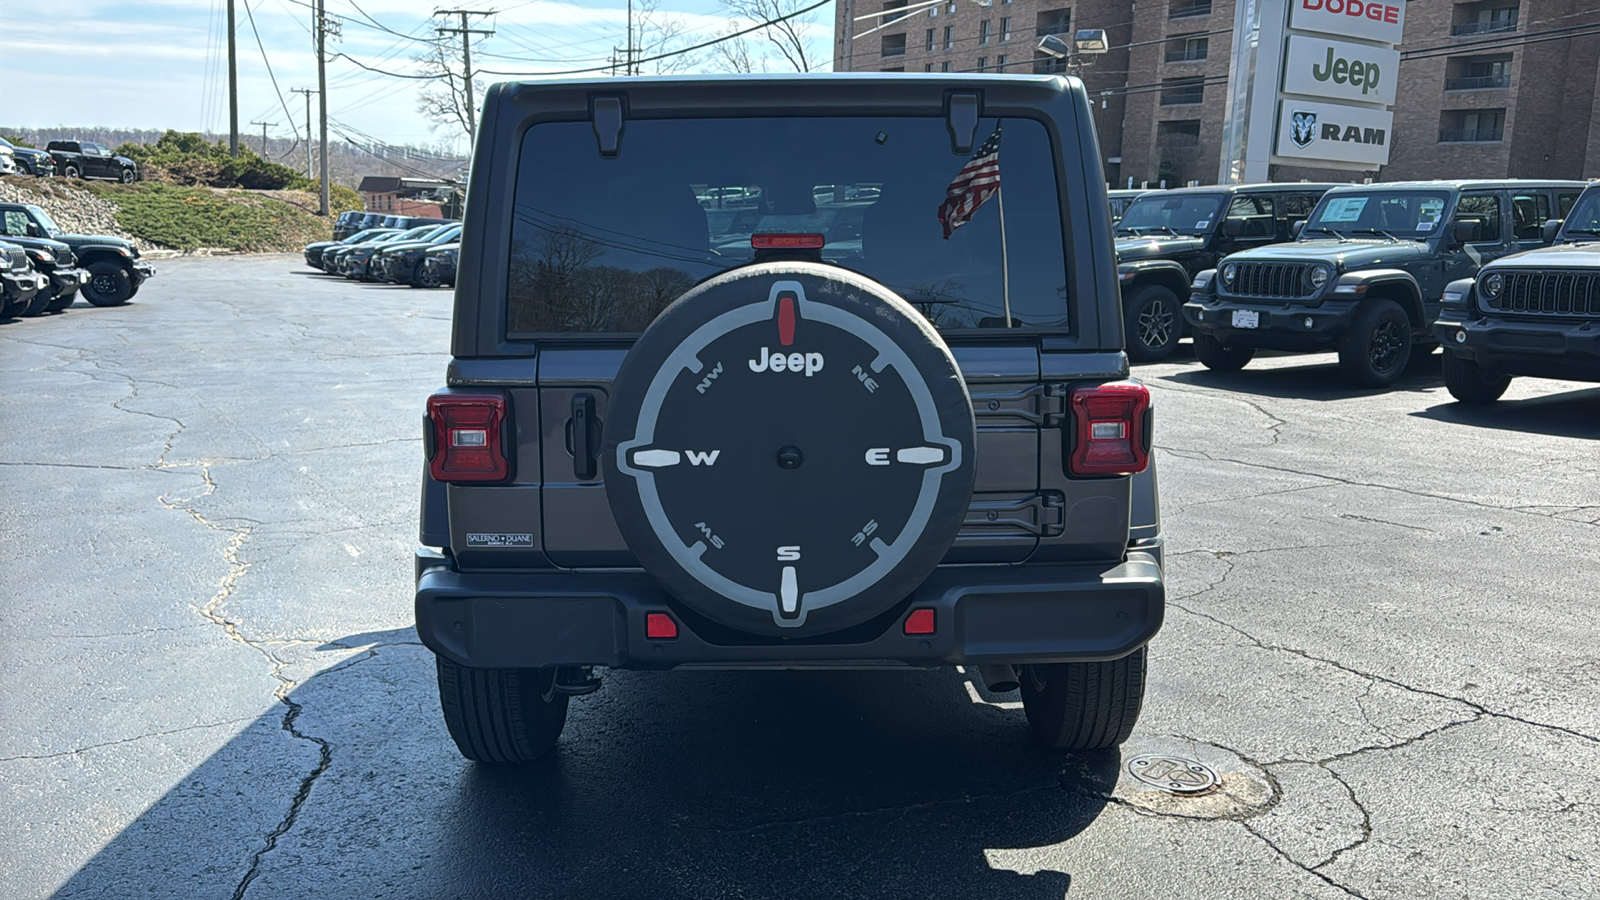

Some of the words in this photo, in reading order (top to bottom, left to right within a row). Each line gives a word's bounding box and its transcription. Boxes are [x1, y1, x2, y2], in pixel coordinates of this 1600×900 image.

[1313, 47, 1380, 95] Jeep
[1321, 123, 1385, 146] RAM
[749, 347, 824, 376] Jeep
[695, 361, 724, 394] NW
[851, 365, 879, 393] NE
[684, 450, 720, 466] W
[865, 448, 890, 465] E
[777, 545, 801, 562] S
